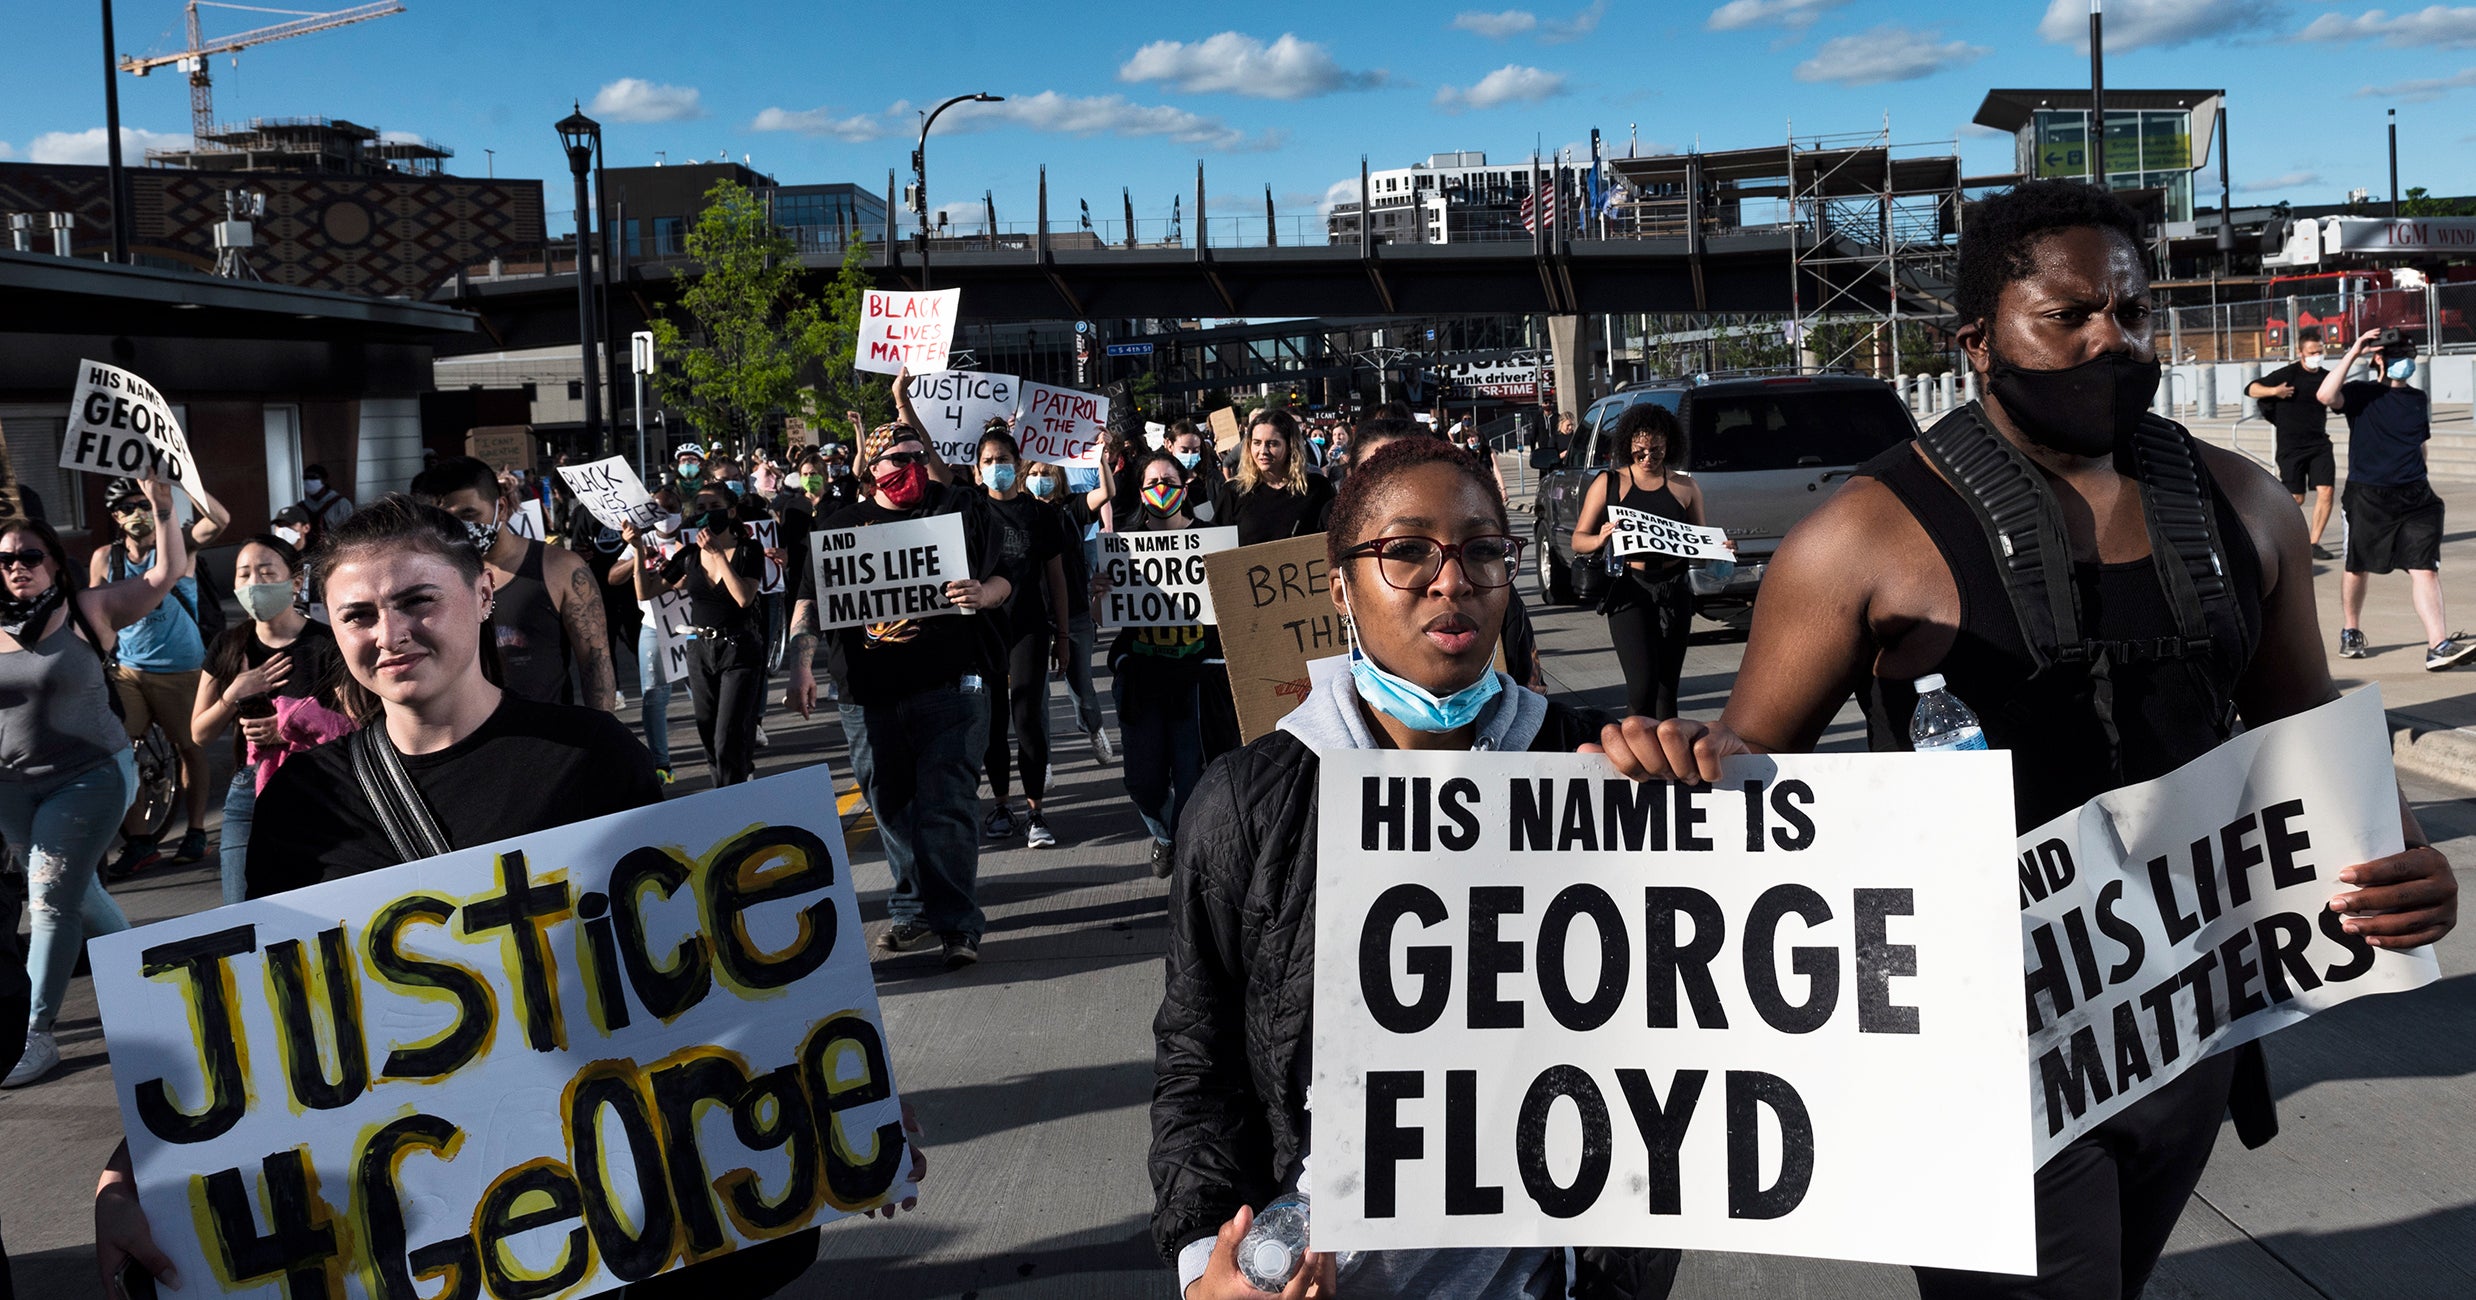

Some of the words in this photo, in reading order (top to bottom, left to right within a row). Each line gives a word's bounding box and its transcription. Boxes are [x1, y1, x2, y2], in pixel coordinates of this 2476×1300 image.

[2385, 223, 2428, 245] TGM
[2437, 229, 2475, 245] WIND
[870, 294, 942, 318] BLACK
[886, 324, 941, 340] LIVES
[870, 341, 948, 362] MATTER
[89, 367, 120, 389] HIS
[127, 378, 161, 409] NAME
[1450, 373, 1484, 385] runk
[1485, 371, 1535, 384] driver?
[945, 406, 963, 429] 4
[1032, 389, 1105, 424] PATROL
[1043, 418, 1075, 434] THE
[75, 431, 182, 482] FLOYD
[931, 441, 975, 463] eorg
[1020, 425, 1098, 460] POLICE
[562, 464, 623, 493] BLACK
[1616, 509, 1637, 518] HIS
[1641, 512, 1676, 528] NAME
[1618, 519, 1713, 545] GEORGE
[822, 532, 856, 552] AND
[1104, 537, 1129, 552] HIS
[1135, 535, 1178, 552] NAME
[1185, 534, 1200, 549] IS
[1622, 535, 1699, 556] FLOYD
[822, 553, 876, 587] HIS
[883, 545, 940, 581] LIFE
[1108, 555, 1205, 587] GEORG
[829, 581, 957, 623] MATTERS
[1111, 592, 1201, 622] FLOYD
[1361, 777, 1481, 852] HIS
[1509, 777, 1713, 852] NAME
[1745, 779, 1816, 852] IS
[2018, 837, 2075, 910] ND
[2023, 879, 2146, 1036] HIS
[2147, 798, 2317, 948] LIFE
[1359, 883, 1920, 1034] GEORGE
[2039, 901, 2376, 1138] MATTERS
[1364, 1064, 1815, 1220] FLOYD
